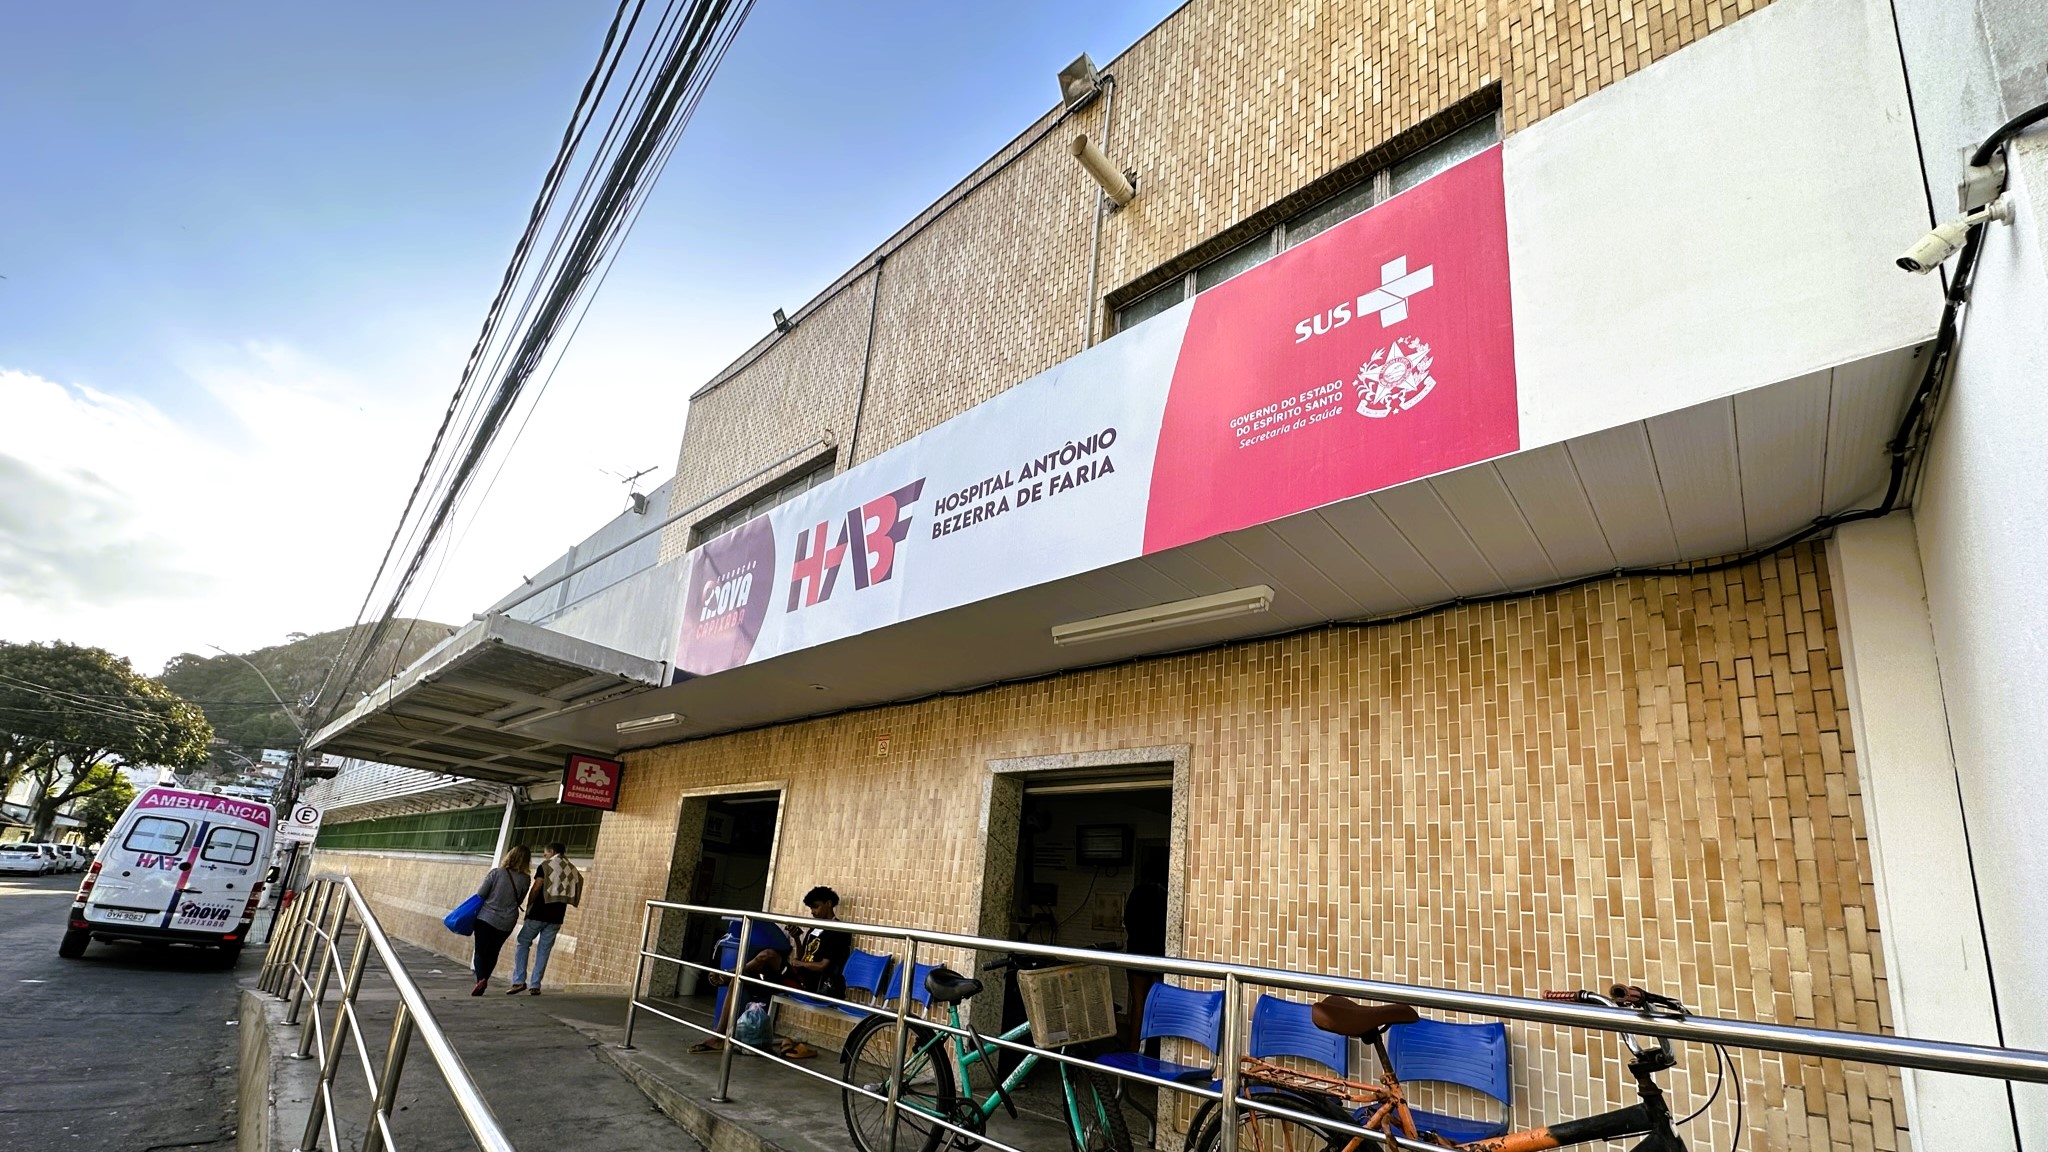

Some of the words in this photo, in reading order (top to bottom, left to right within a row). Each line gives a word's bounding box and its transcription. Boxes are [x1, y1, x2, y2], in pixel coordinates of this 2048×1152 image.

[1295, 301, 1352, 344] SUS
[1230, 403, 1279, 429] GOVERNO
[1281, 396, 1297, 410] DO
[1300, 379, 1343, 404] ESTADO
[1236, 422, 1251, 437] DO
[1253, 407, 1302, 432] ESPÍRITO
[1305, 391, 1343, 413] SANTO
[1239, 424, 1291, 449] Secretaria
[1293, 417, 1307, 431] da
[1308, 404, 1343, 425] Saúde
[934, 469, 1014, 517] HOSPITAL
[1018, 427, 1117, 483] ANTÔNIO
[932, 495, 1010, 540] BEZERRA
[1016, 482, 1043, 508] DE
[1049, 455, 1115, 496] FARIA
[786, 476, 927, 613] HABF
[696, 608, 746, 640] CAPIXABA
[145, 793, 267, 822] AMBULÂNCIA
[567, 791, 611, 803] DESEMBARQUE
[572, 785, 604, 796] EMBARQUE
[301, 810, 312, 821] E
[177, 917, 225, 928] CAPIXABA
